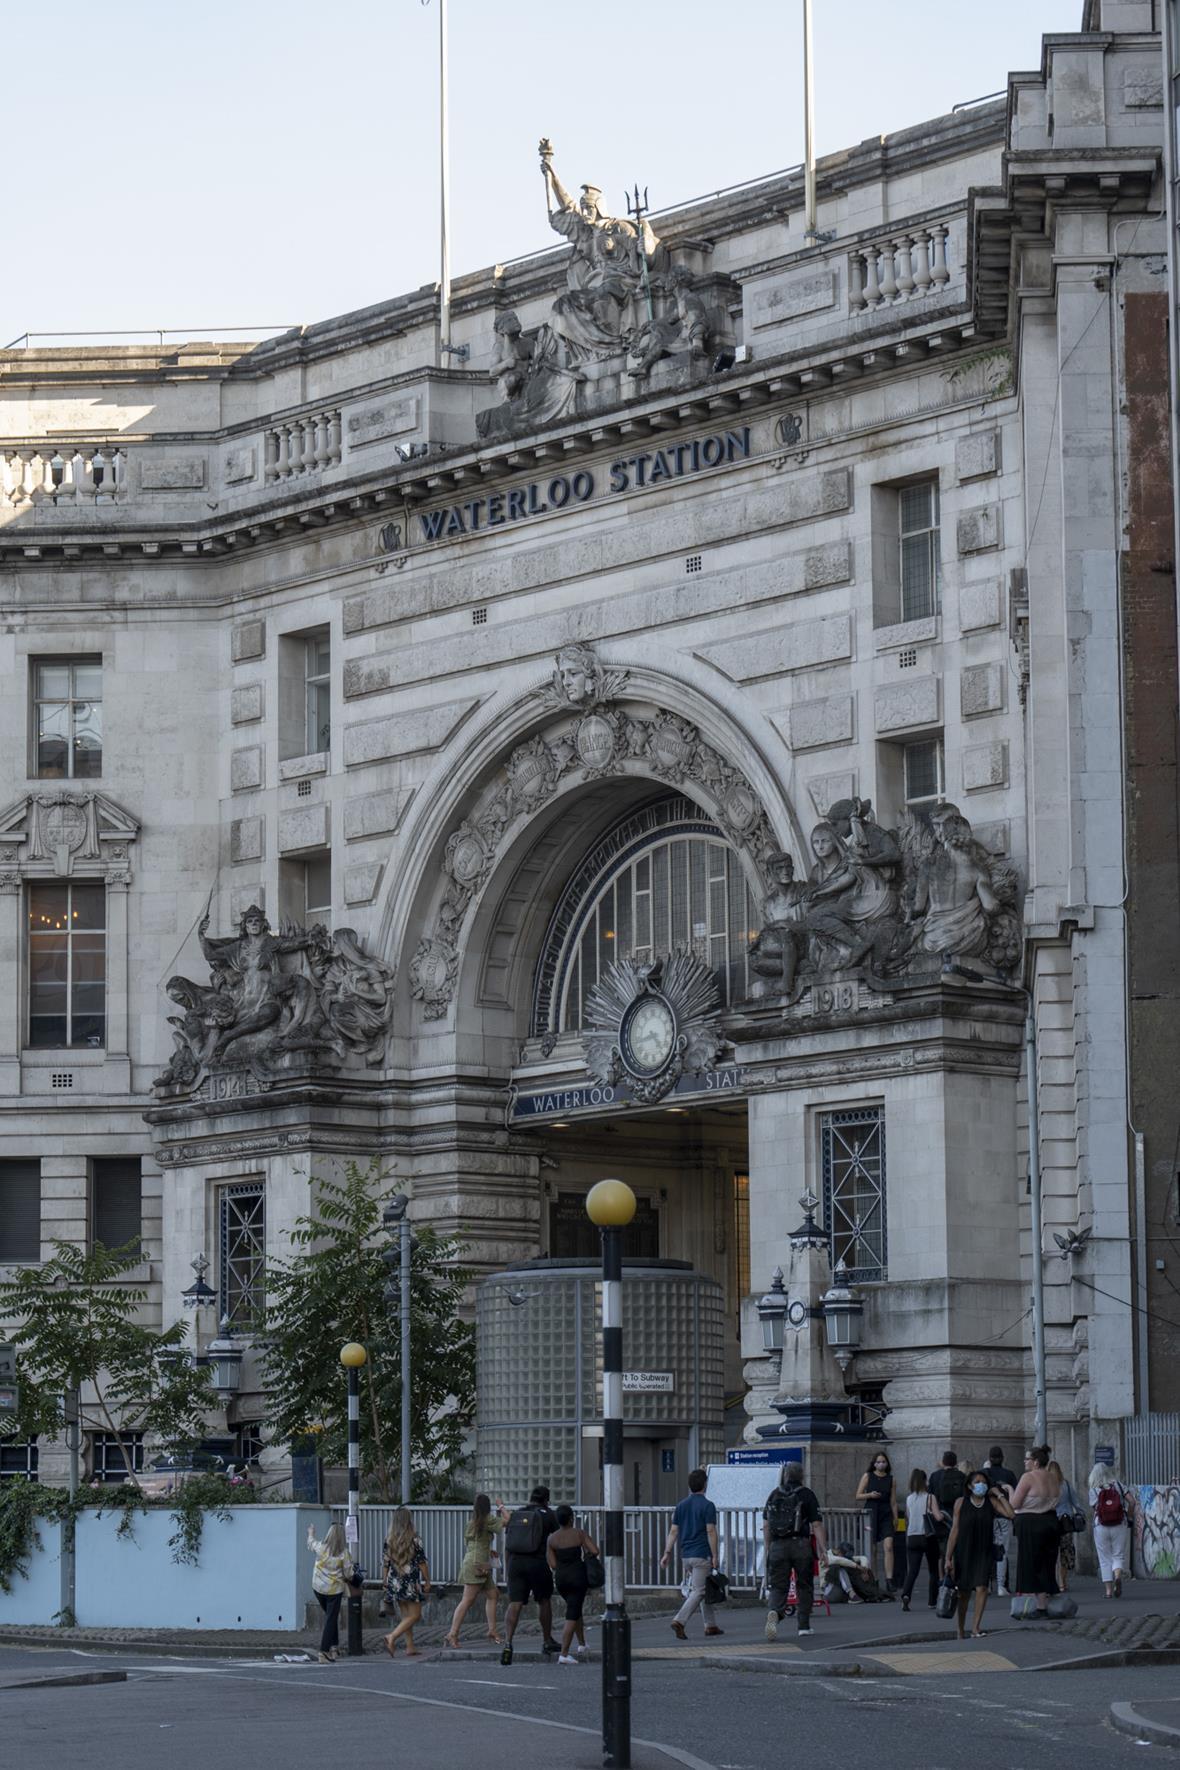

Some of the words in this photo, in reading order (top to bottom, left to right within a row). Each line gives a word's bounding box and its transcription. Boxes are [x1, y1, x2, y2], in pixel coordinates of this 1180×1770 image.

[420, 469, 594, 540] WATERLOO
[609, 427, 751, 493] STATION
[813, 985, 853, 1013] 1918
[213, 1079, 241, 1100] 1914
[533, 1086, 615, 1113] WATERLOO
[706, 1069, 751, 1089] STAT
[630, 1373, 639, 1381] To
[640, 1373, 670, 1382] Subway
